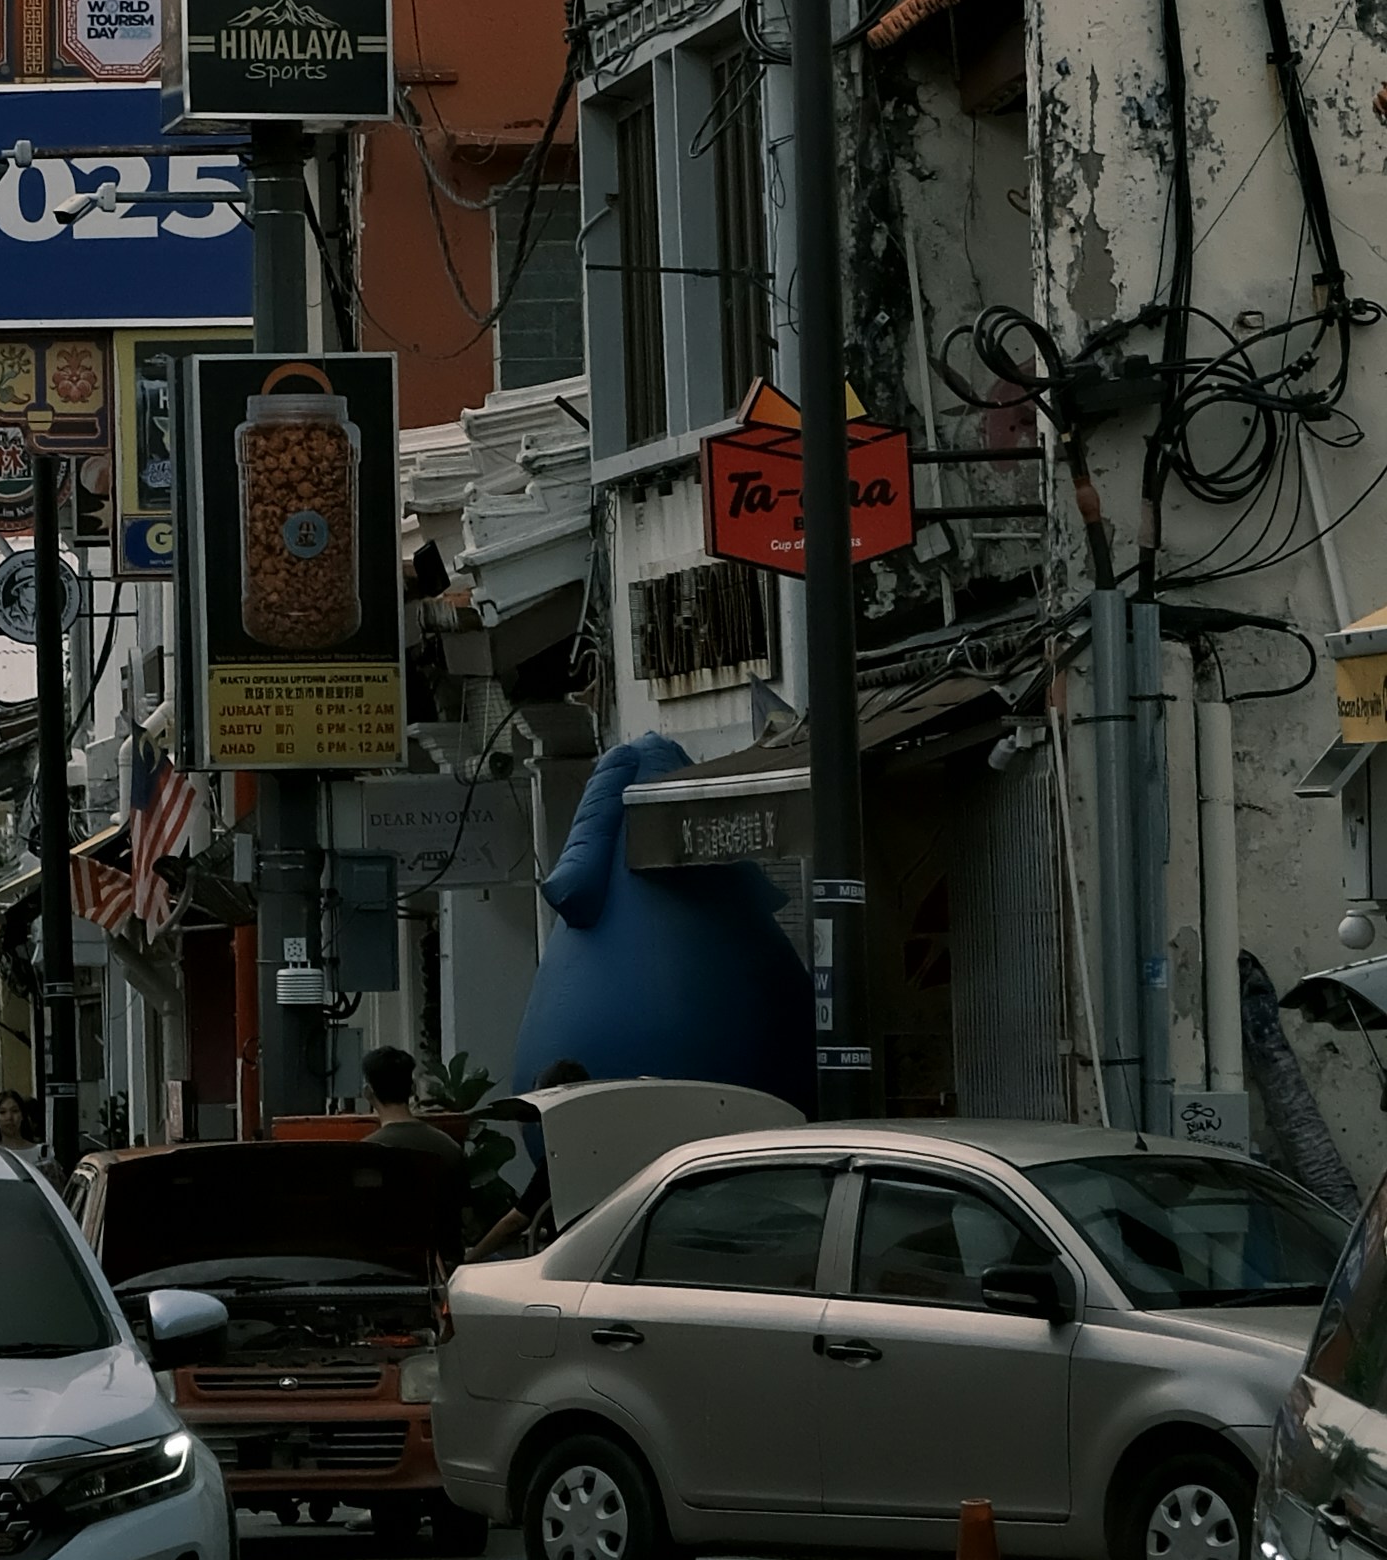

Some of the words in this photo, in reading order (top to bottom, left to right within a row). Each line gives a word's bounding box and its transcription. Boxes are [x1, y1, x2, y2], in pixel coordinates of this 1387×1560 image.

[87, 13, 155, 27] TOURISM
[87, 27, 119, 40] DAY
[219, 28, 354, 62] HIMALAYA
[245, 61, 328, 90] Sports
[770, 539, 792, 553] Cup
[220, 676, 250, 685] WAKTU
[328, 675, 362, 684] JONKER
[364, 675, 388, 683] WALK
[219, 705, 271, 717] JUMAAT
[315, 704, 323, 715] 6
[327, 704, 345, 715] PM
[356, 703, 371, 715] 12
[375, 703, 395, 715] AM
[219, 724, 262, 736] SABTU
[316, 723, 324, 735] 6
[327, 723, 346, 734] PM
[357, 723, 372, 734] 12
[375, 723, 395, 734] AM
[219, 743, 256, 755] AHAD
[316, 742, 324, 753] 6
[328, 742, 346, 753] PM
[358, 742, 372, 753] 12
[375, 742, 395, 753] AM
[370, 812, 416, 826] DEAR
[421, 809, 494, 824] NYONYA
